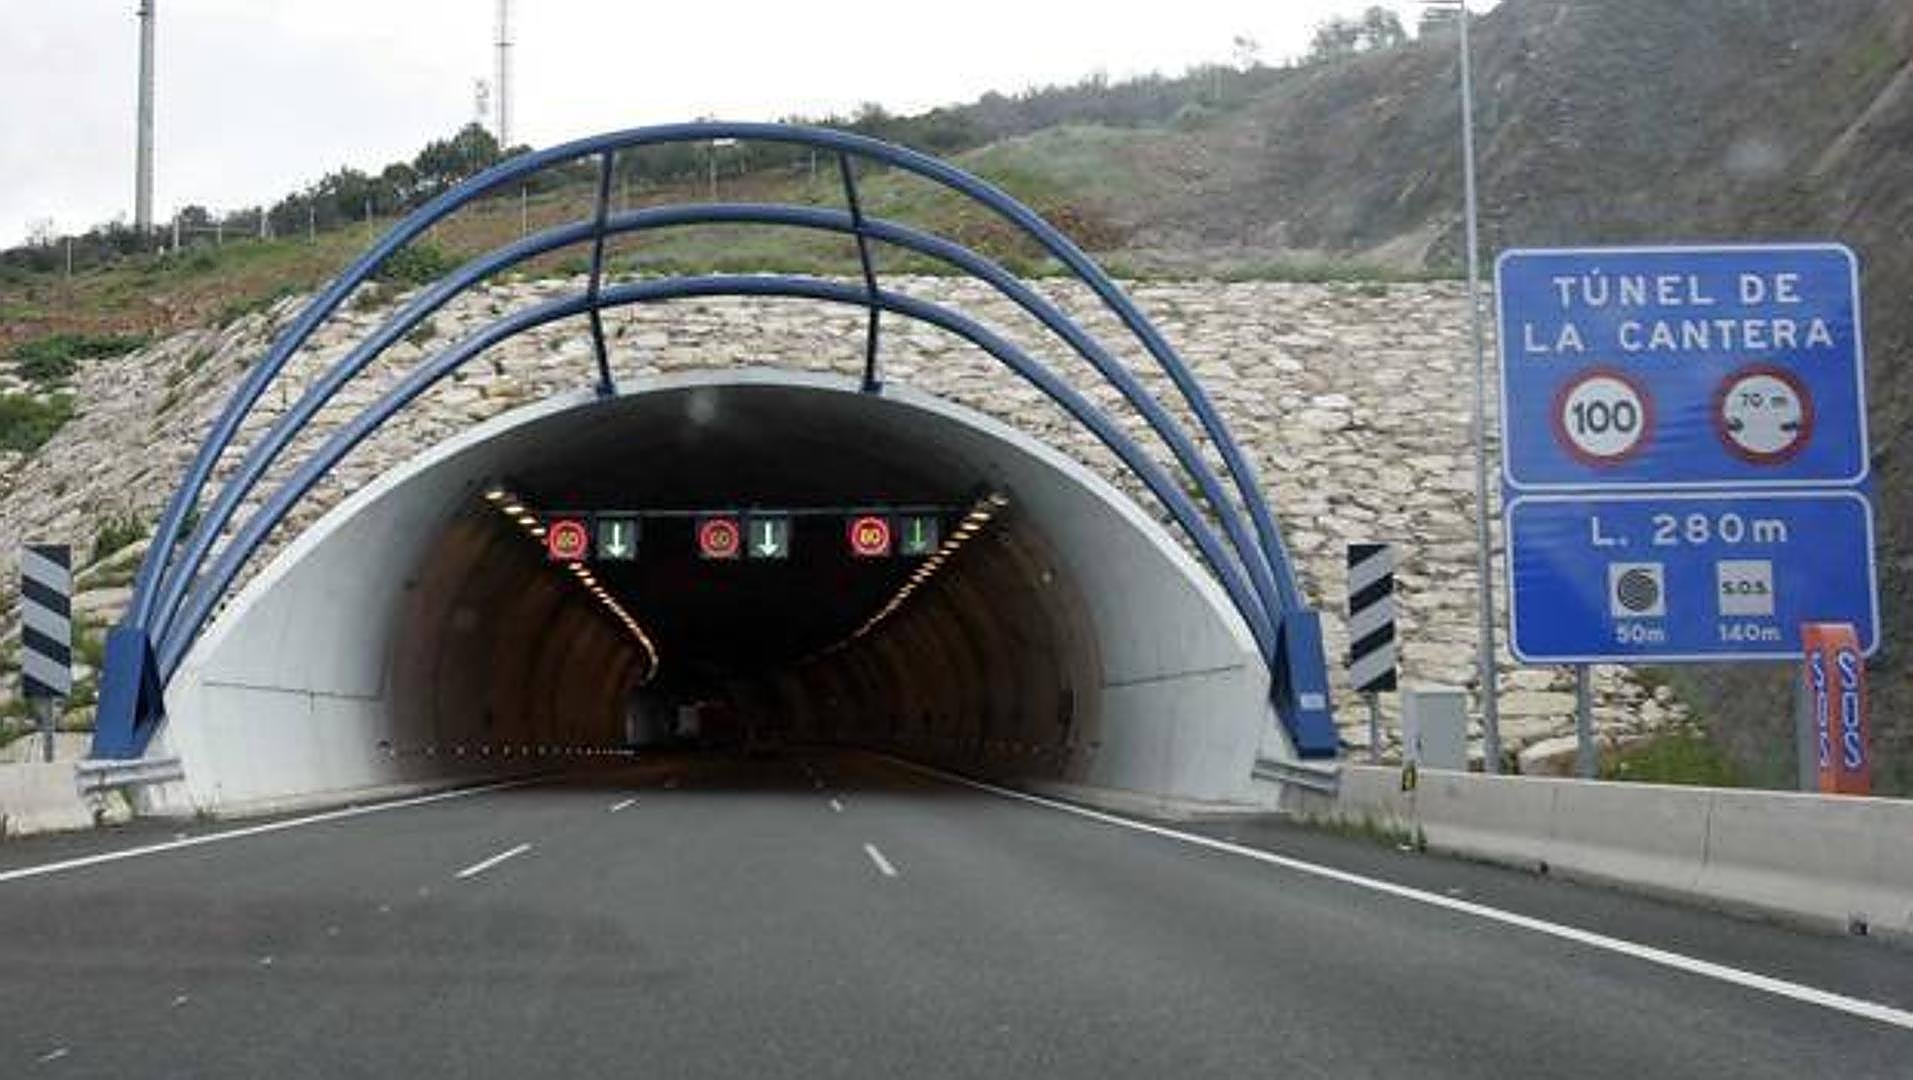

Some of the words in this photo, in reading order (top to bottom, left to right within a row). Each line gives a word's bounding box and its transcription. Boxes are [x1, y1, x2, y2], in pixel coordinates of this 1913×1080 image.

[1554, 268, 1714, 305] TÚNEL
[1740, 272, 1800, 304] DE
[1524, 322, 1584, 352] LA
[1619, 318, 1834, 350] CANTERA
[1571, 401, 1638, 434] 100
[1592, 516, 1628, 546] L.
[1653, 513, 1787, 545] 280m
[1616, 624, 1665, 643] 50m
[1720, 624, 1781, 641] 140m
[1812, 652, 1830, 767] SOS
[1838, 651, 1862, 768] SOS
